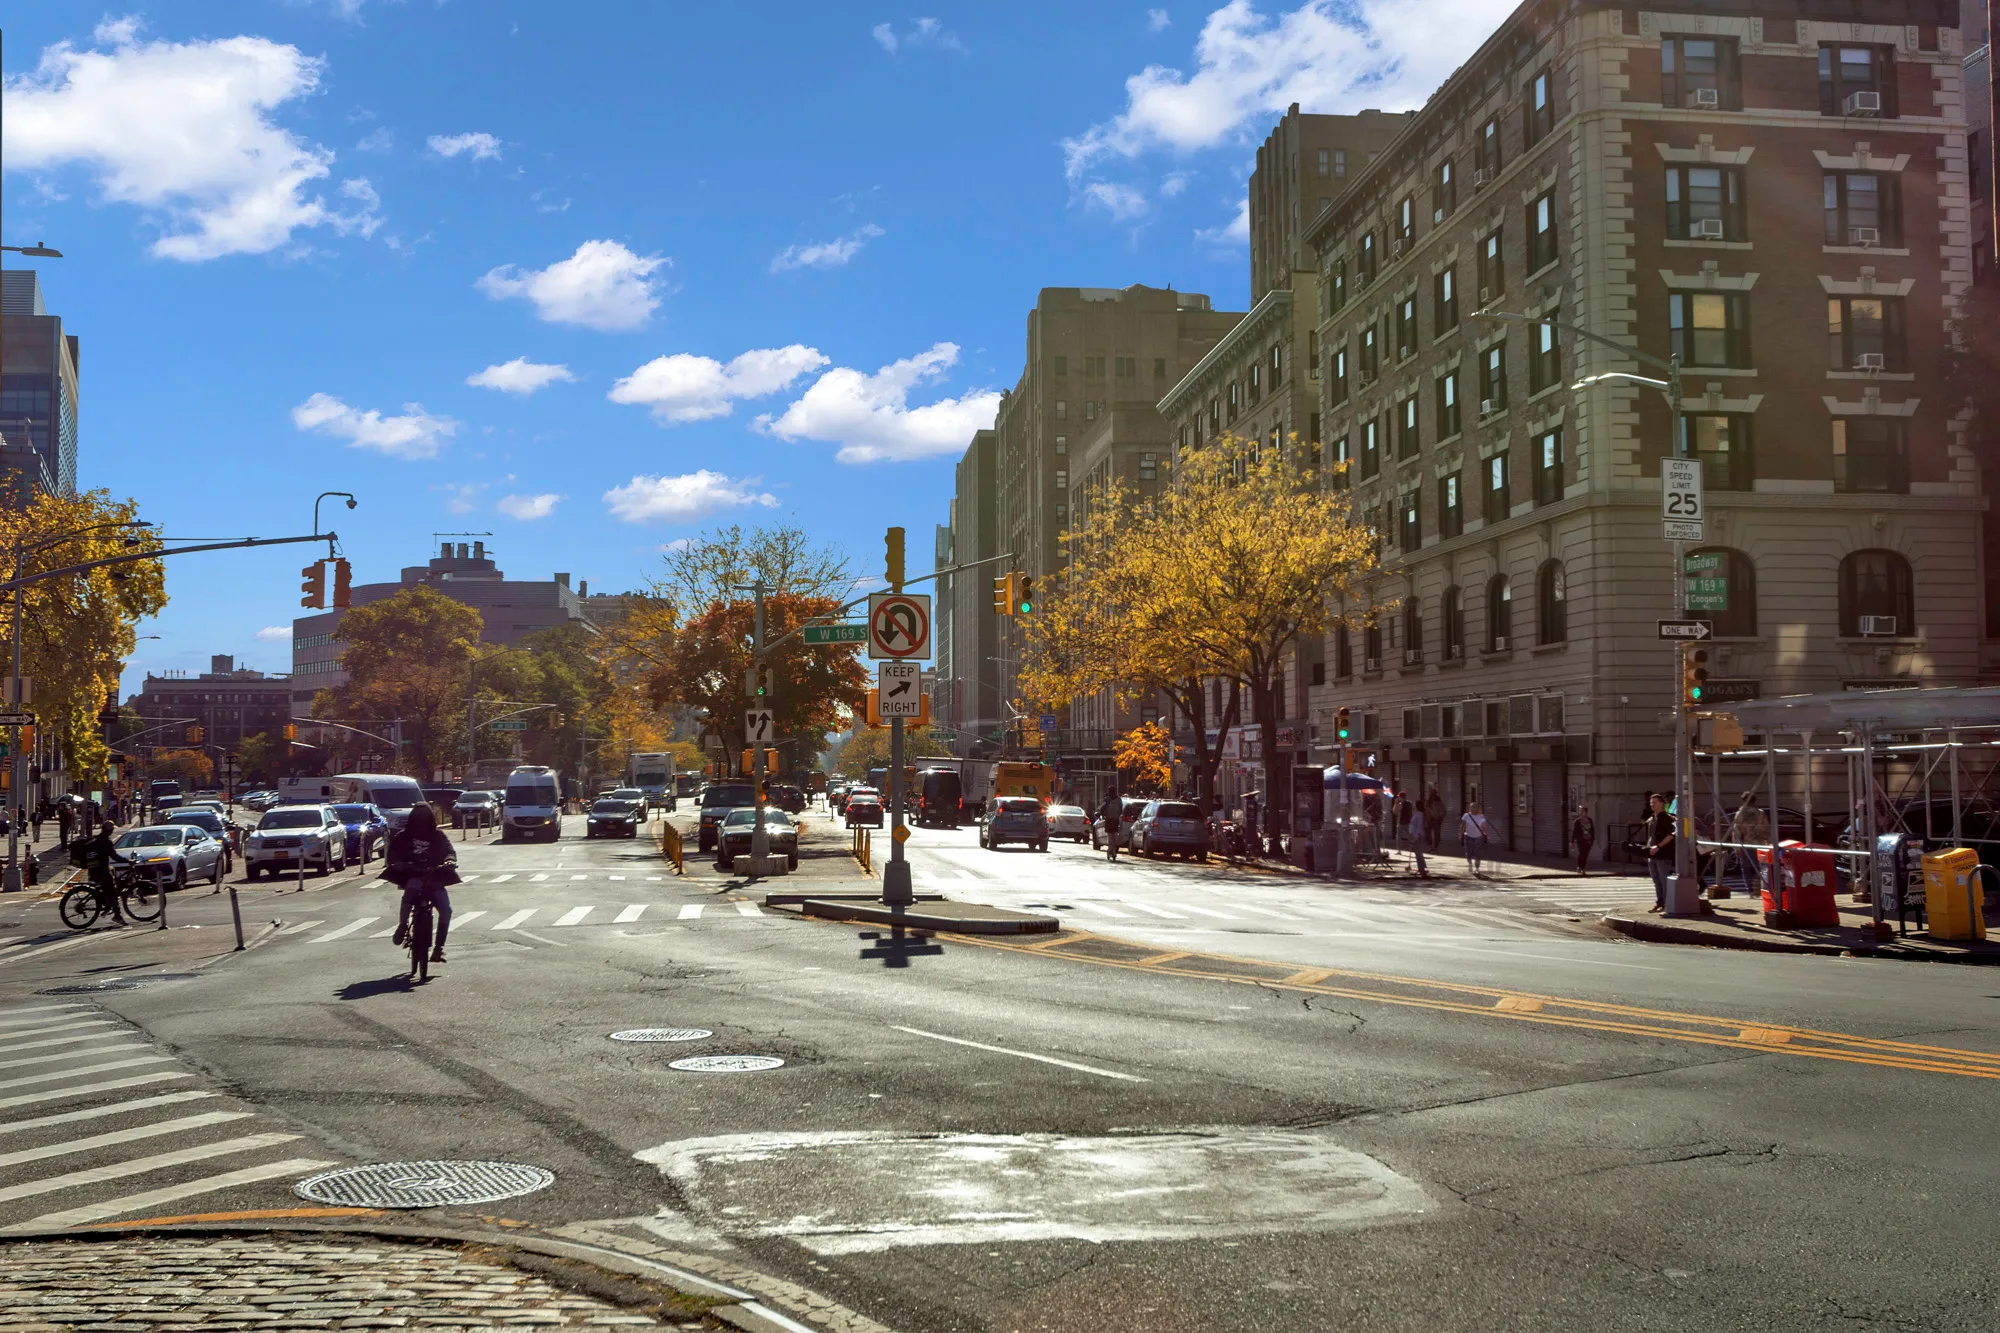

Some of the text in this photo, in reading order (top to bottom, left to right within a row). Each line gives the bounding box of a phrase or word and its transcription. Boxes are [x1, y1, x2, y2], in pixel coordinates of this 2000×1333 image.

[1669, 472, 1693, 480] SPEED
[1668, 492, 1698, 515] 25
[1672, 523, 1694, 531] PHOTO
[1666, 530, 1700, 538] ENFORCED
[1686, 556, 1719, 571] Broadway
[1688, 579, 1697, 591] W
[1700, 579, 1716, 591] 169
[1691, 595, 1724, 604] Coogan's
[820, 627, 869, 640] W 169 S
[1665, 626, 1704, 635] ONE WAY
[885, 666, 914, 677] KEEP
[1707, 684, 1754, 695] OGAN'S
[883, 702, 917, 713] RIGHT
